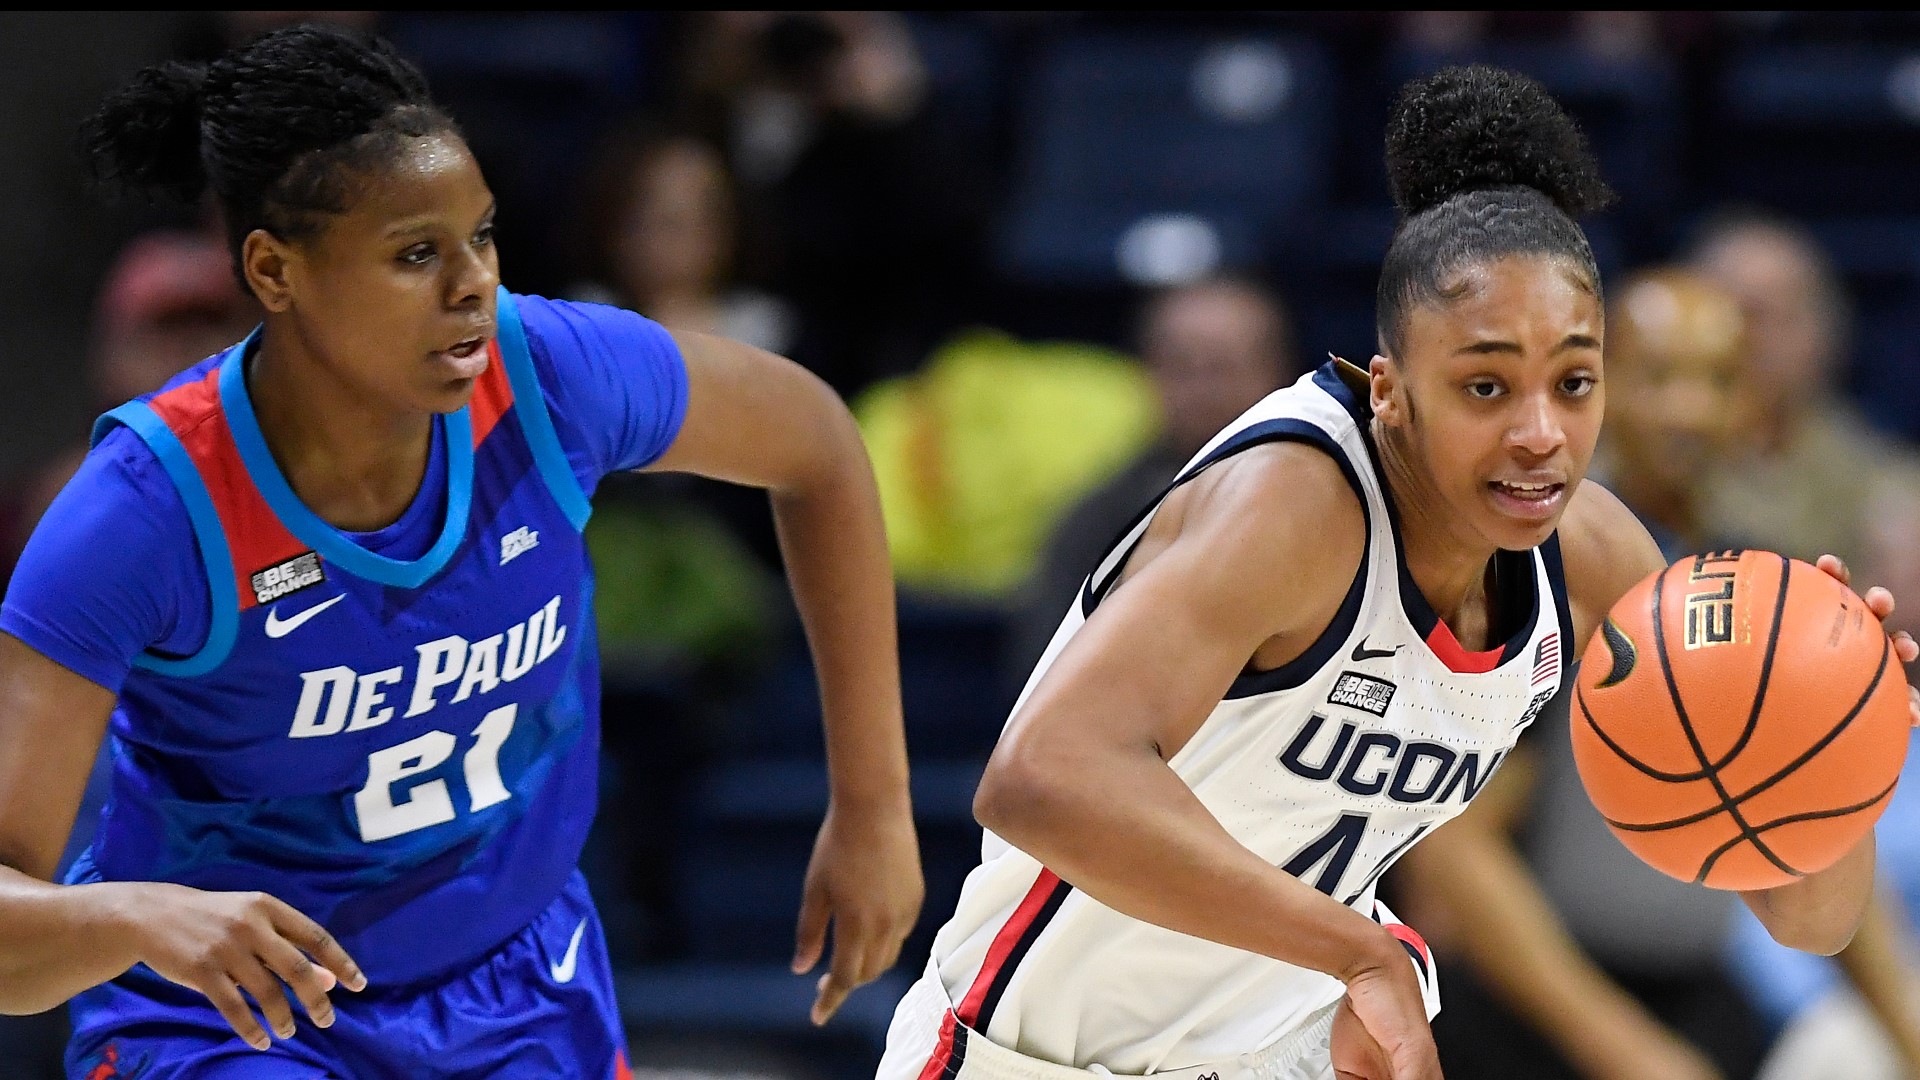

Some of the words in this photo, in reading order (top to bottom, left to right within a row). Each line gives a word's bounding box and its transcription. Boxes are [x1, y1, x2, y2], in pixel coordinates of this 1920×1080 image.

[257, 568, 322, 603] CHANGE
[263, 560, 296, 588] BE
[1343, 675, 1374, 696] BE
[1330, 690, 1387, 713] CHANGE
[353, 702, 519, 843] 21
[1276, 710, 1513, 805] UCON
